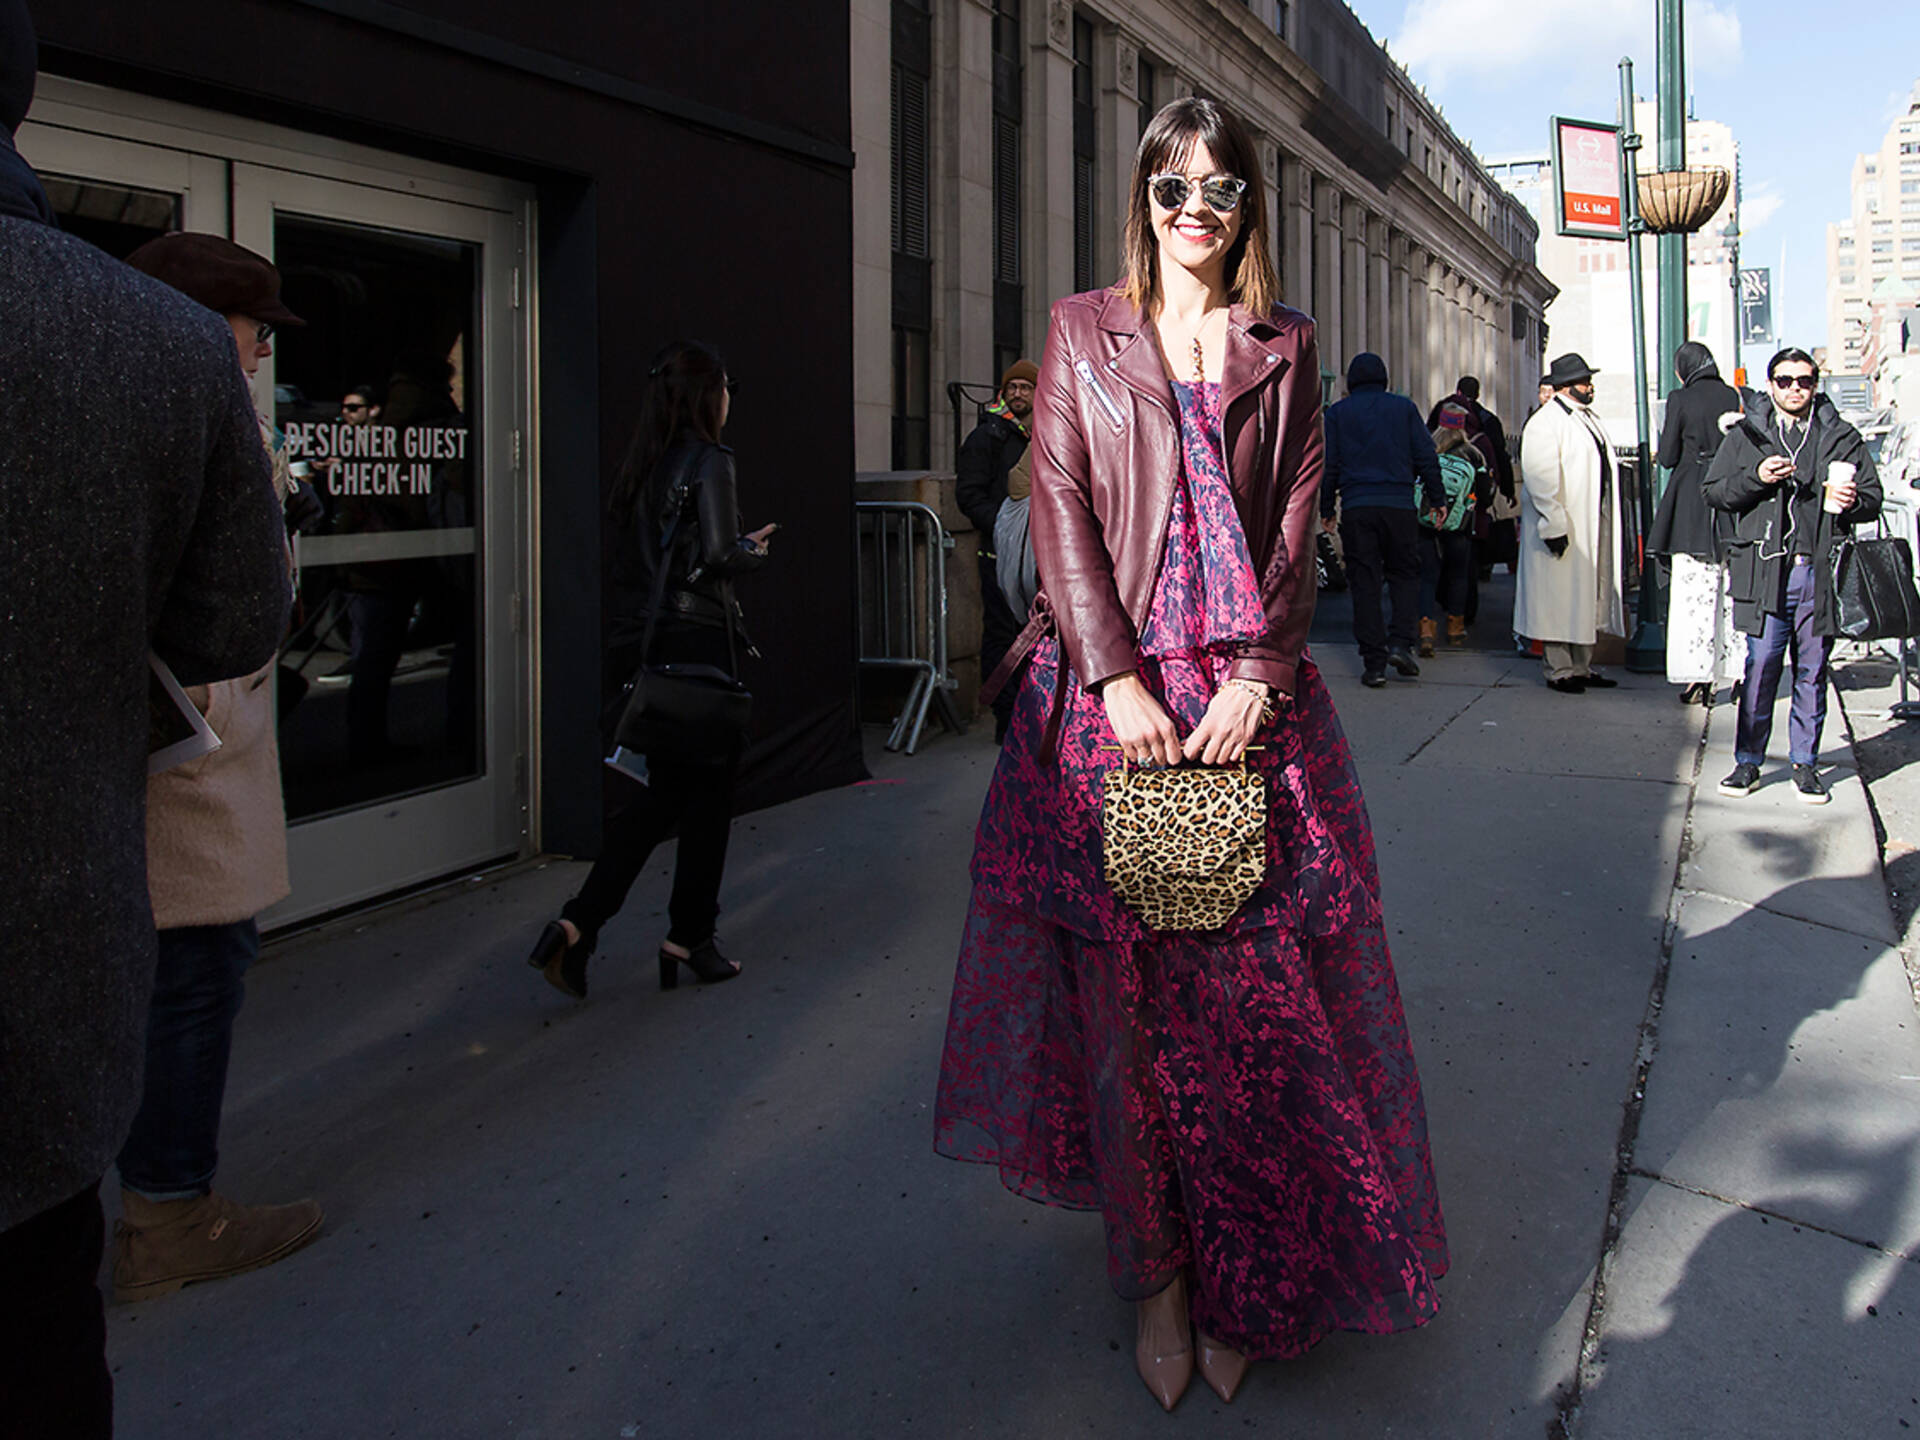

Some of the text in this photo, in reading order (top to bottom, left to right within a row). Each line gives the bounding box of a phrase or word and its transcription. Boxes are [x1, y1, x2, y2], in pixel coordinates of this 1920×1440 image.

[1574, 202, 1611, 215] U.S. Mail
[285, 422, 468, 459] DESIGNER GUEST
[327, 462, 432, 496] CHECK-IN
